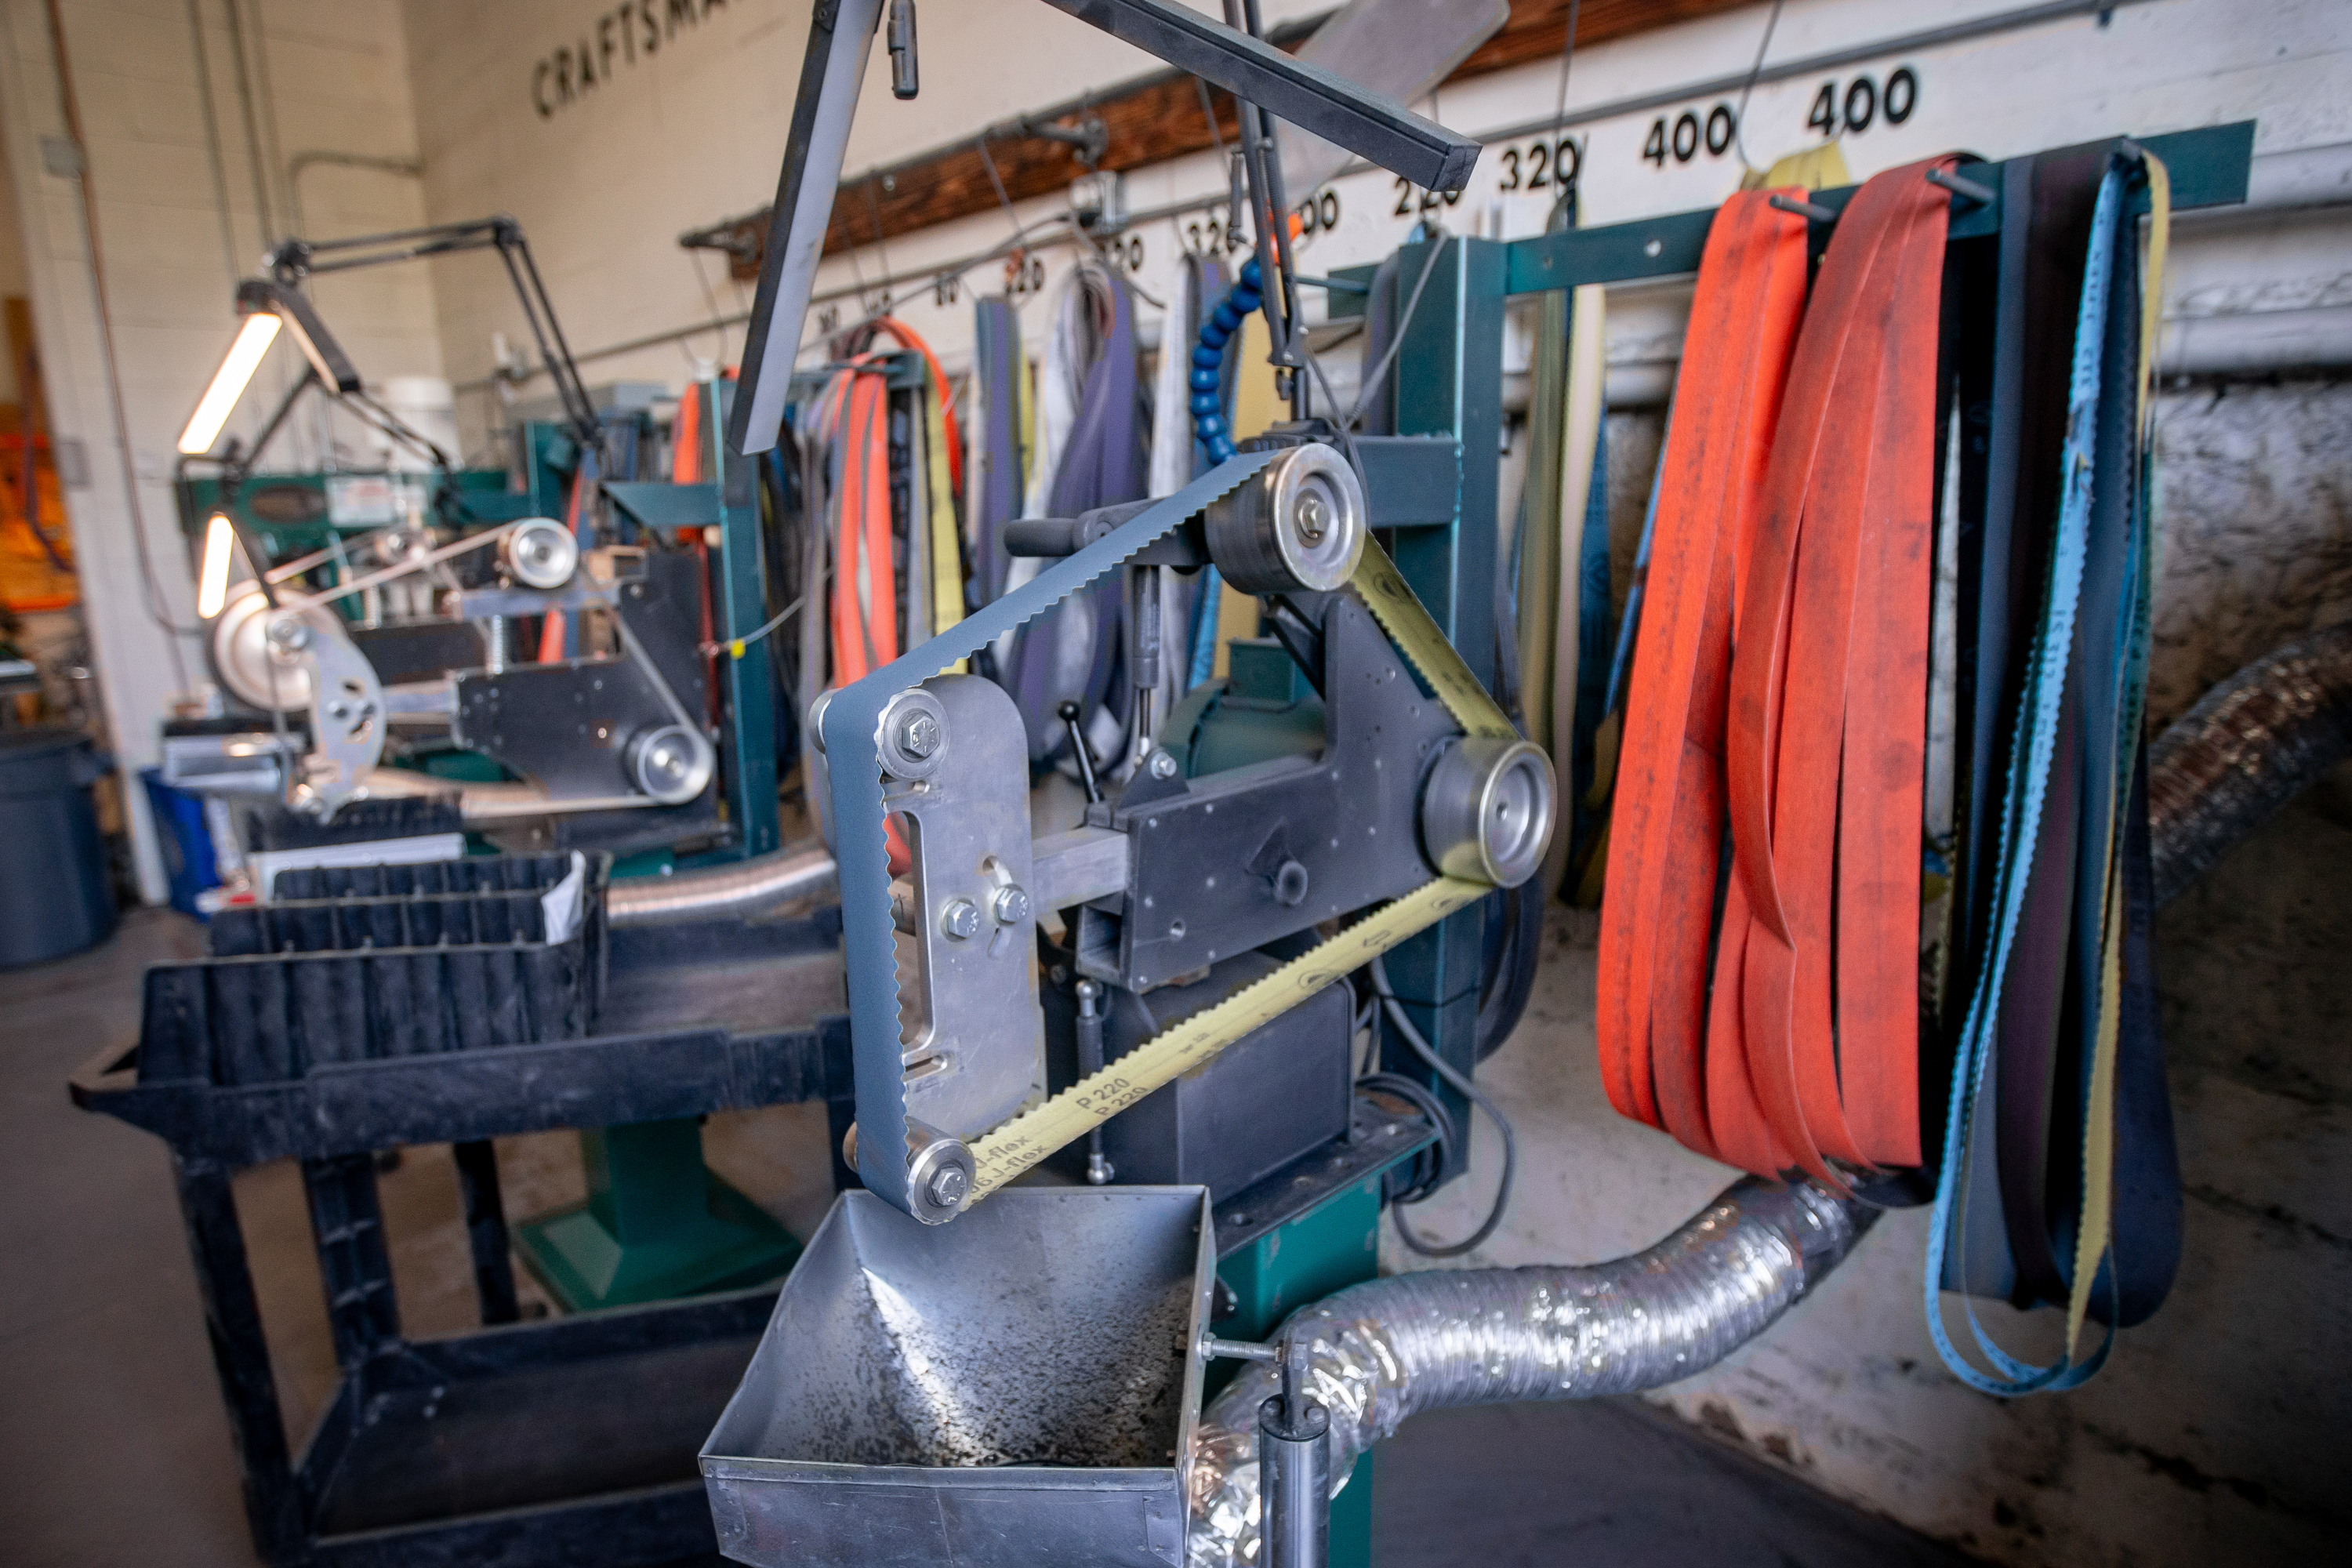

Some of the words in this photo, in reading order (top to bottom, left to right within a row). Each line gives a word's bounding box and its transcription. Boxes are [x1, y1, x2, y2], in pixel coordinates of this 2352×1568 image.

[1642, 103, 1737, 169] 400
[1808, 67, 1918, 136] 400
[1500, 139, 1578, 193] 320
[976, 1135, 1033, 1171] J-flex
[1076, 1097, 1093, 1110] P
[1093, 1078, 1131, 1100] 220
[995, 1145, 1049, 1178] J-flex
[1094, 1106, 1109, 1116] P
[1111, 1086, 1148, 1107] 220
